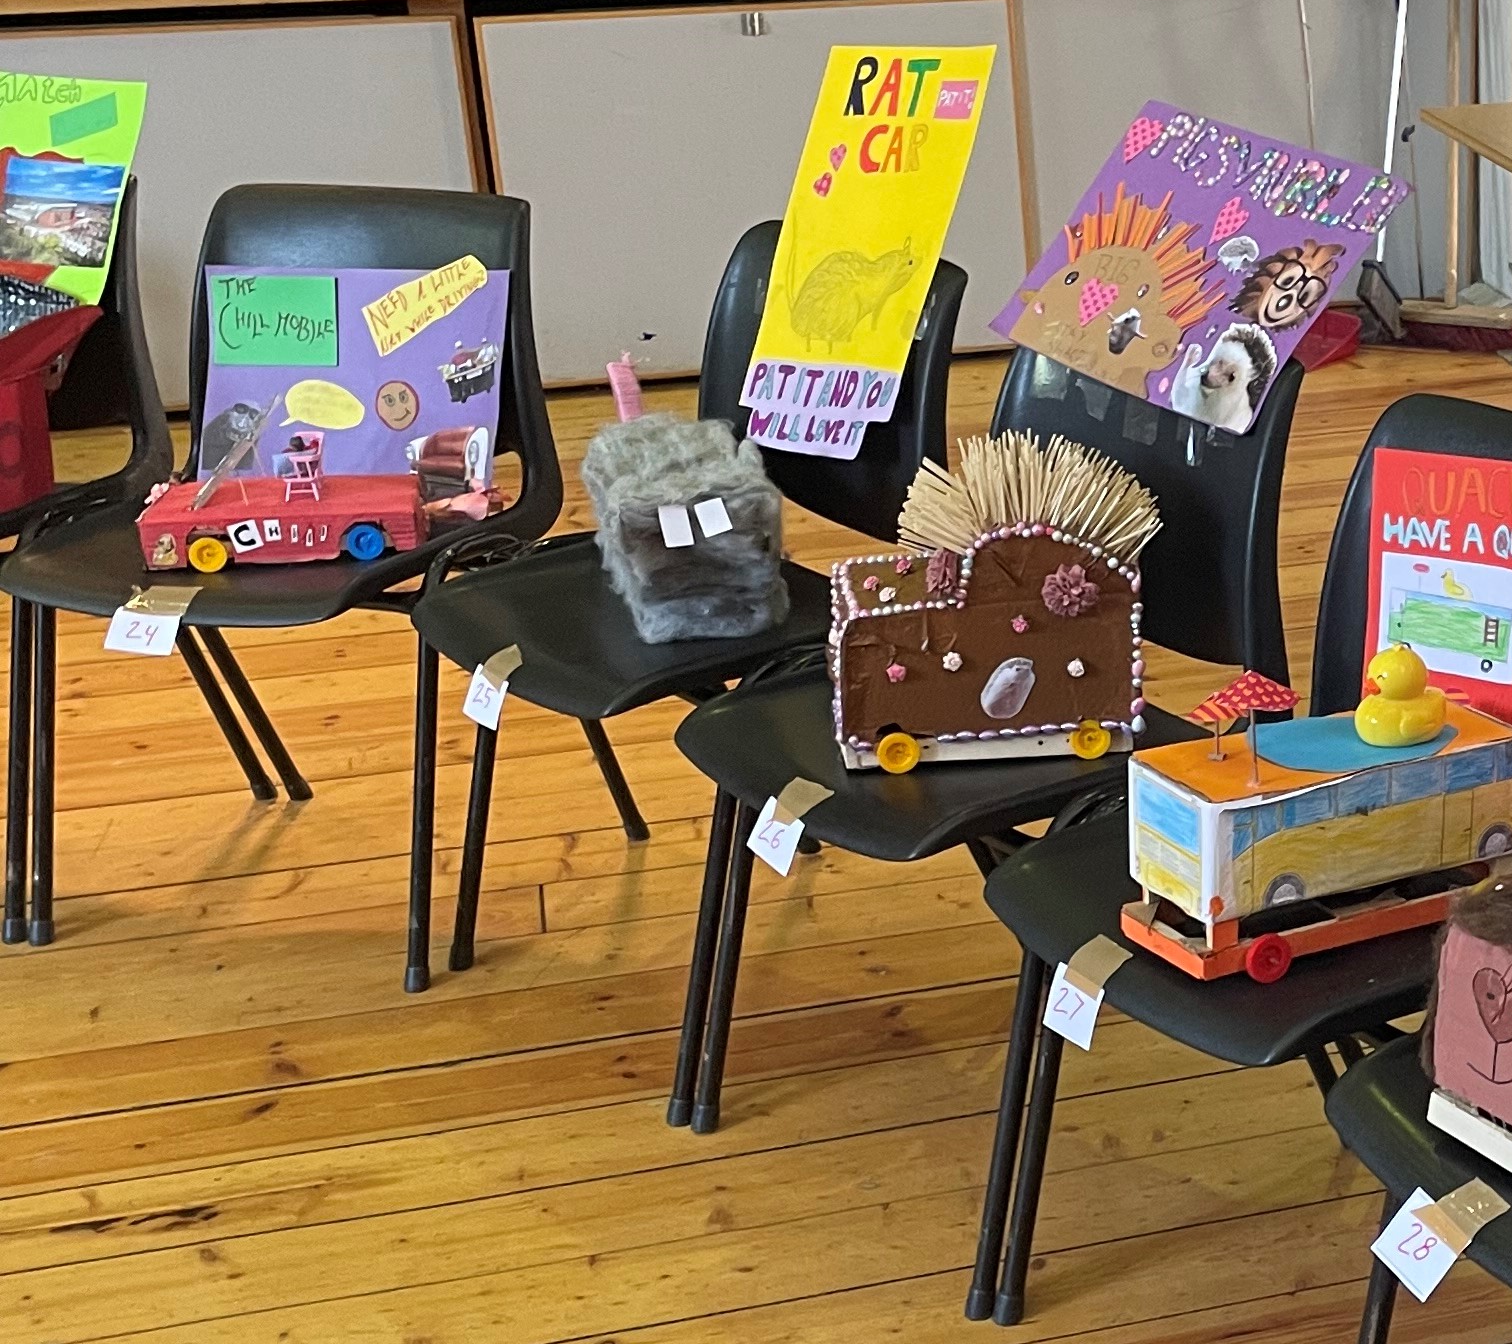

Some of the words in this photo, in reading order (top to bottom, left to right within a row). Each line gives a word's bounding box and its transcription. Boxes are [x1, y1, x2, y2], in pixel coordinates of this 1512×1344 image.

[842, 56, 942, 118] RAT
[859, 123, 929, 174] CAR
[218, 277, 257, 299] THE
[218, 302, 270, 350] CHILL
[366, 289, 408, 337] NEED
[748, 363, 797, 401] PAT
[793, 367, 824, 408] IT
[816, 369, 859, 409] AND
[857, 369, 897, 410] YOU
[750, 409, 801, 443] WILL
[804, 414, 845, 445] LOVE
[843, 420, 865, 446] IT
[1382, 512, 1452, 552] HAVE
[1462, 522, 1485, 555] A
[125, 620, 159, 647] 24
[472, 682, 495, 709] 25
[758, 818, 785, 849] 26
[1053, 987, 1085, 1021] 27
[1397, 1222, 1438, 1261] 28
